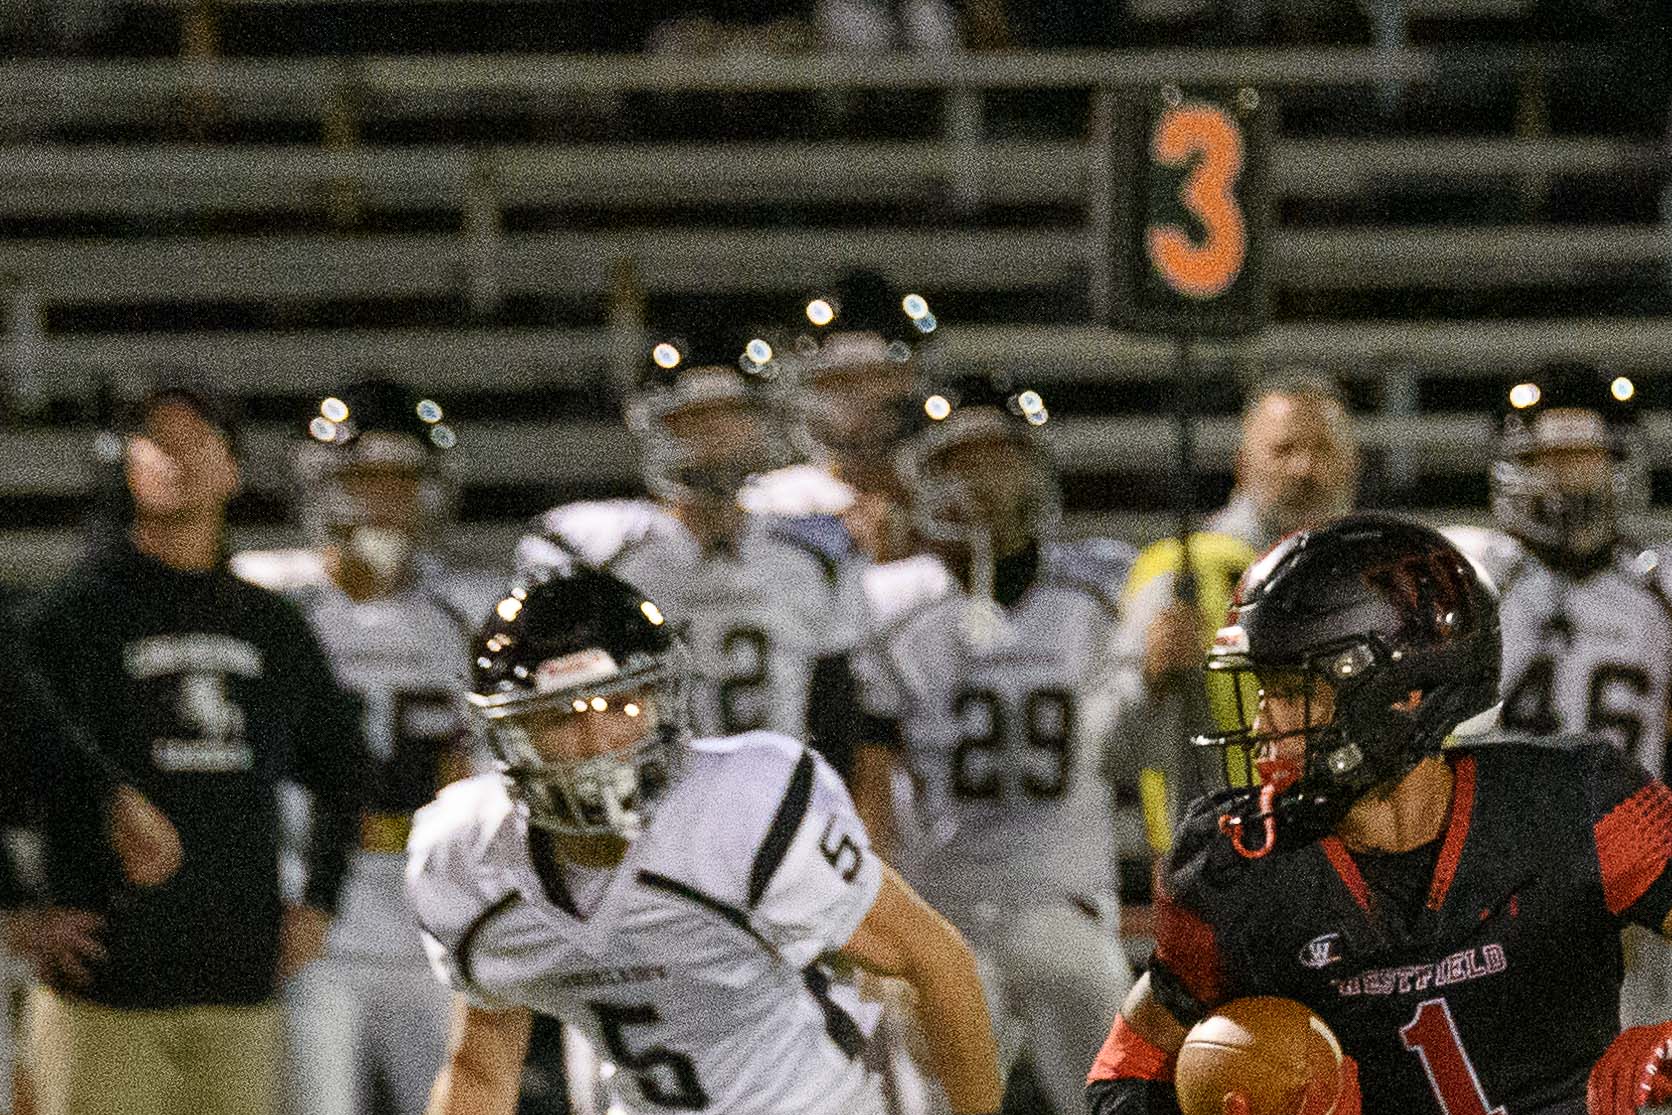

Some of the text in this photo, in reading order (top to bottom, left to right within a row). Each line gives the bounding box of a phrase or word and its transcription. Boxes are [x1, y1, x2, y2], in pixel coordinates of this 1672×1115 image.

[1149, 103, 1247, 298] 3
[951, 686, 1074, 799] 29
[818, 815, 862, 882] 5
[590, 999, 713, 1112] 5
